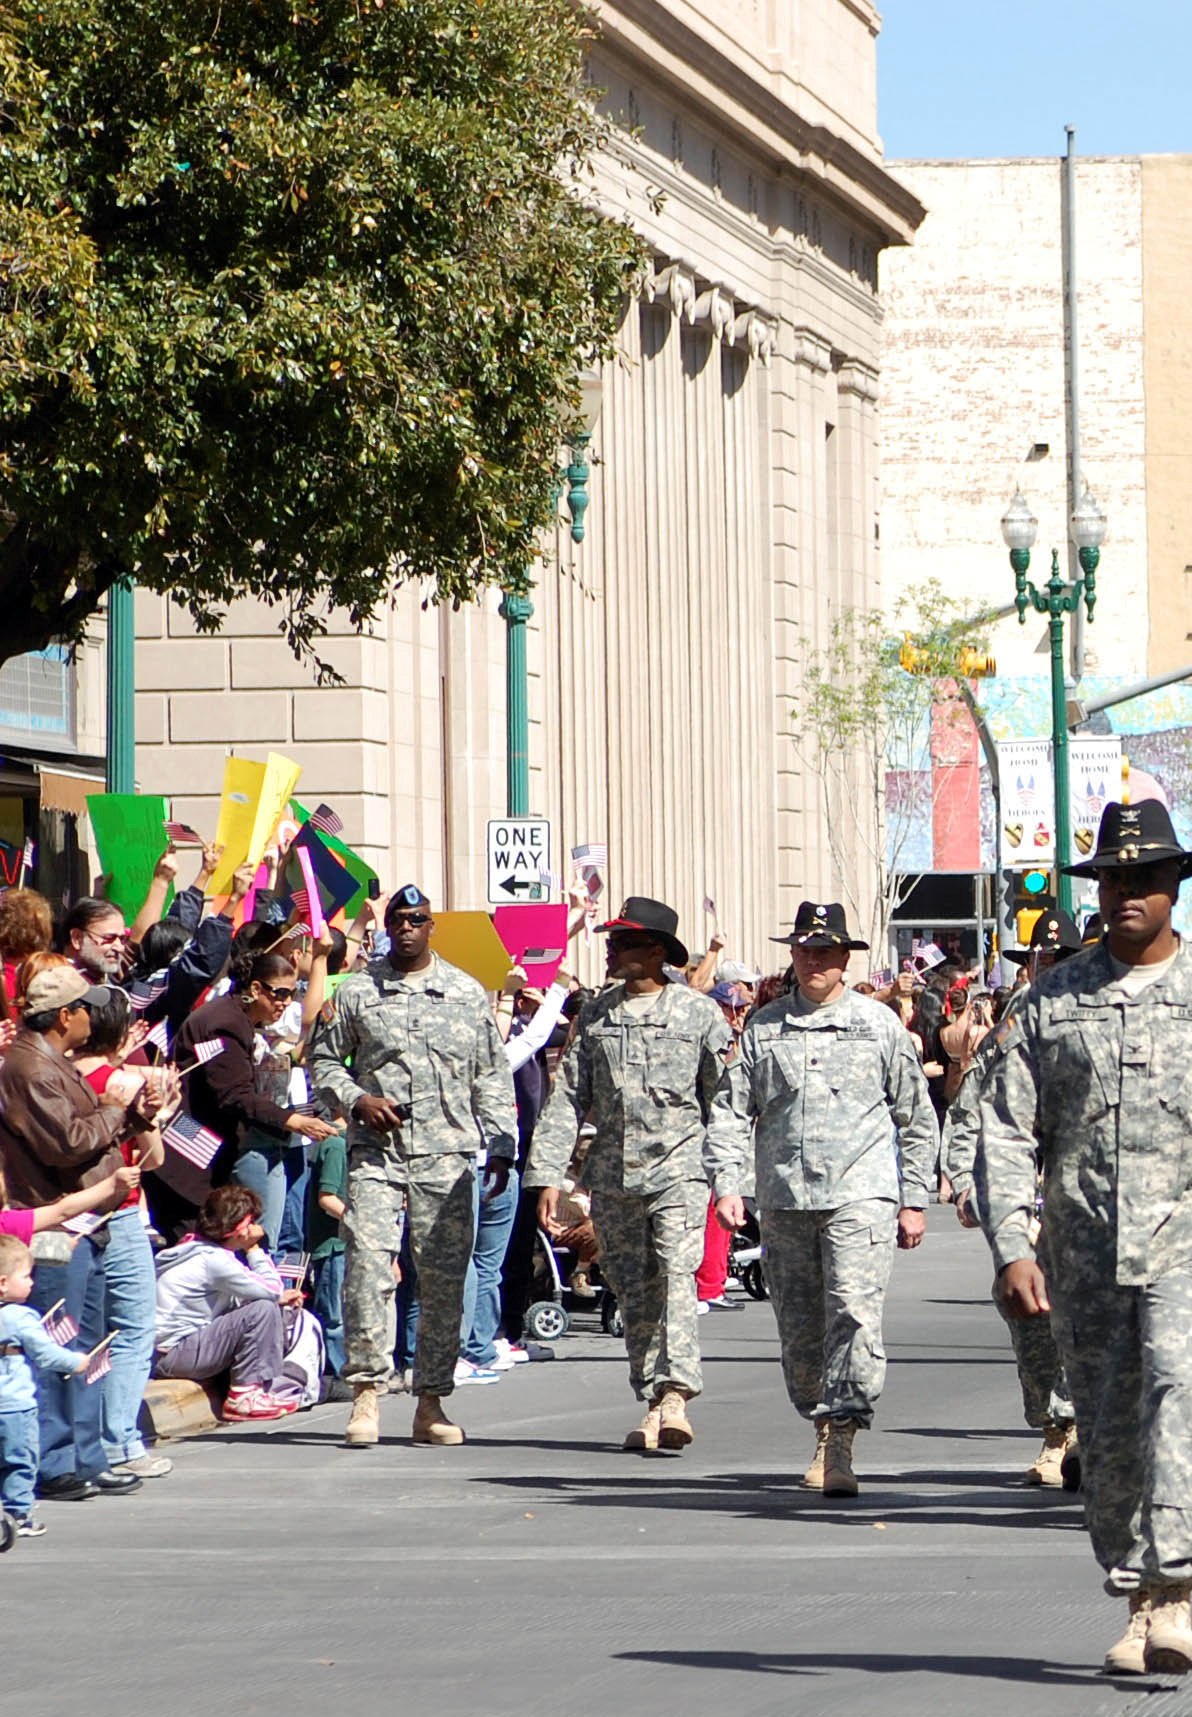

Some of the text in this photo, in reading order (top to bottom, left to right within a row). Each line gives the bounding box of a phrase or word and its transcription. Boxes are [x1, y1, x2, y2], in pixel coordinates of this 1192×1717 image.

[1001, 744, 1049, 753] WELCOME
[1071, 751, 1119, 760] WELCOME
[1081, 765, 1109, 774] HOME
[496, 827, 543, 847] ONE
[495, 850, 543, 870] WAY
